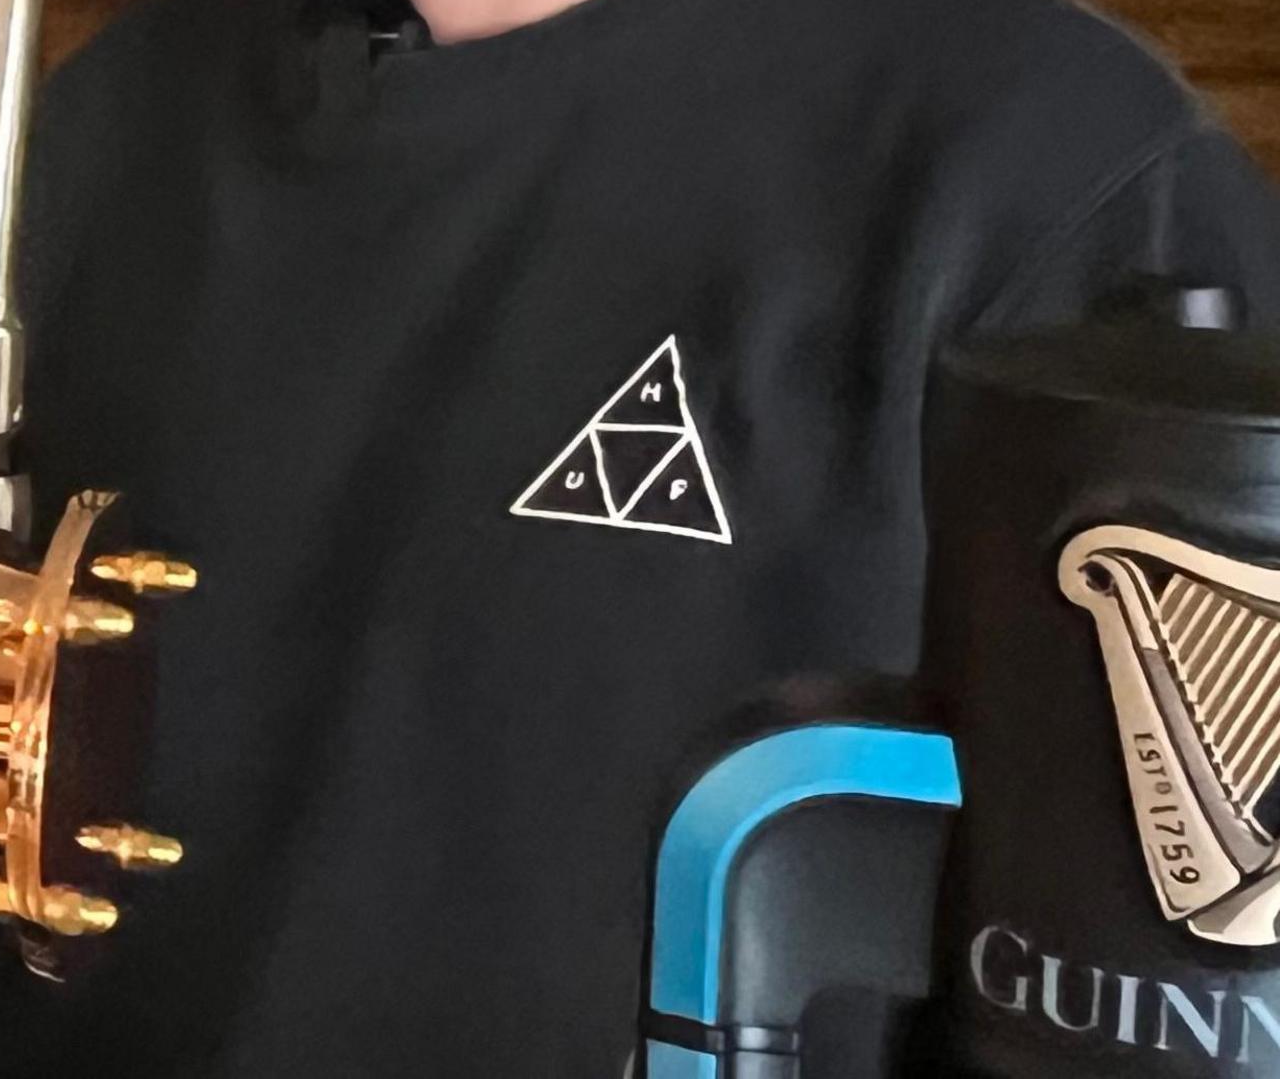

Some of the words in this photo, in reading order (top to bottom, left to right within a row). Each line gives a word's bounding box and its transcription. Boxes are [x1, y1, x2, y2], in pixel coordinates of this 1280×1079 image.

[640, 382, 663, 402] H
[565, 471, 585, 490] U
[1149, 803, 1201, 885] 1759
